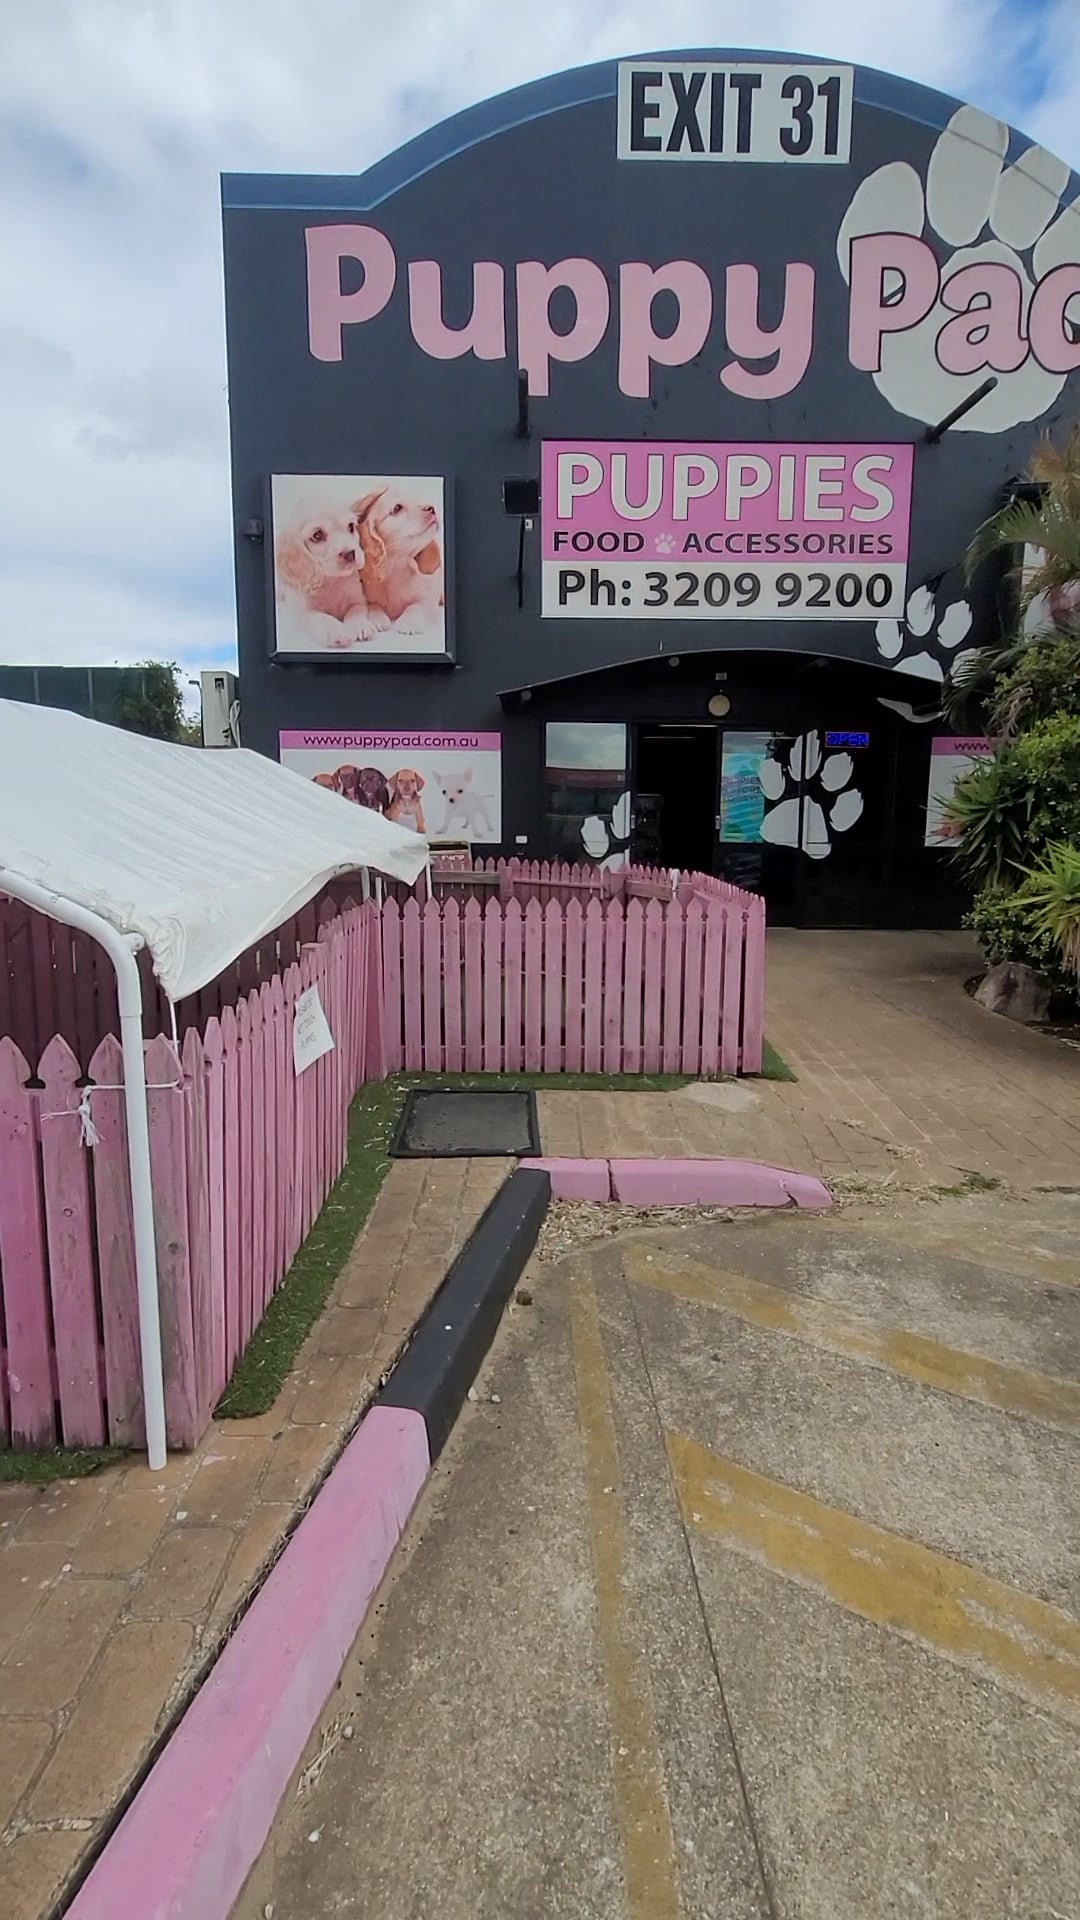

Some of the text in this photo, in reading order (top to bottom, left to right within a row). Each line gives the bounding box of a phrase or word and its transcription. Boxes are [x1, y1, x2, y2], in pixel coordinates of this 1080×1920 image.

[630, 71, 841, 156] EXIT 31
[304, 222, 814, 399] Puppy
[556, 452, 895, 522] PUPPIES
[553, 531, 893, 555] FOOD ACCESSORIES
[558, 568, 893, 607] Ph: 3209 9200
[303, 735, 479, 748] www.puppypad.com.au
[827, 733, 868, 746] OPEN
